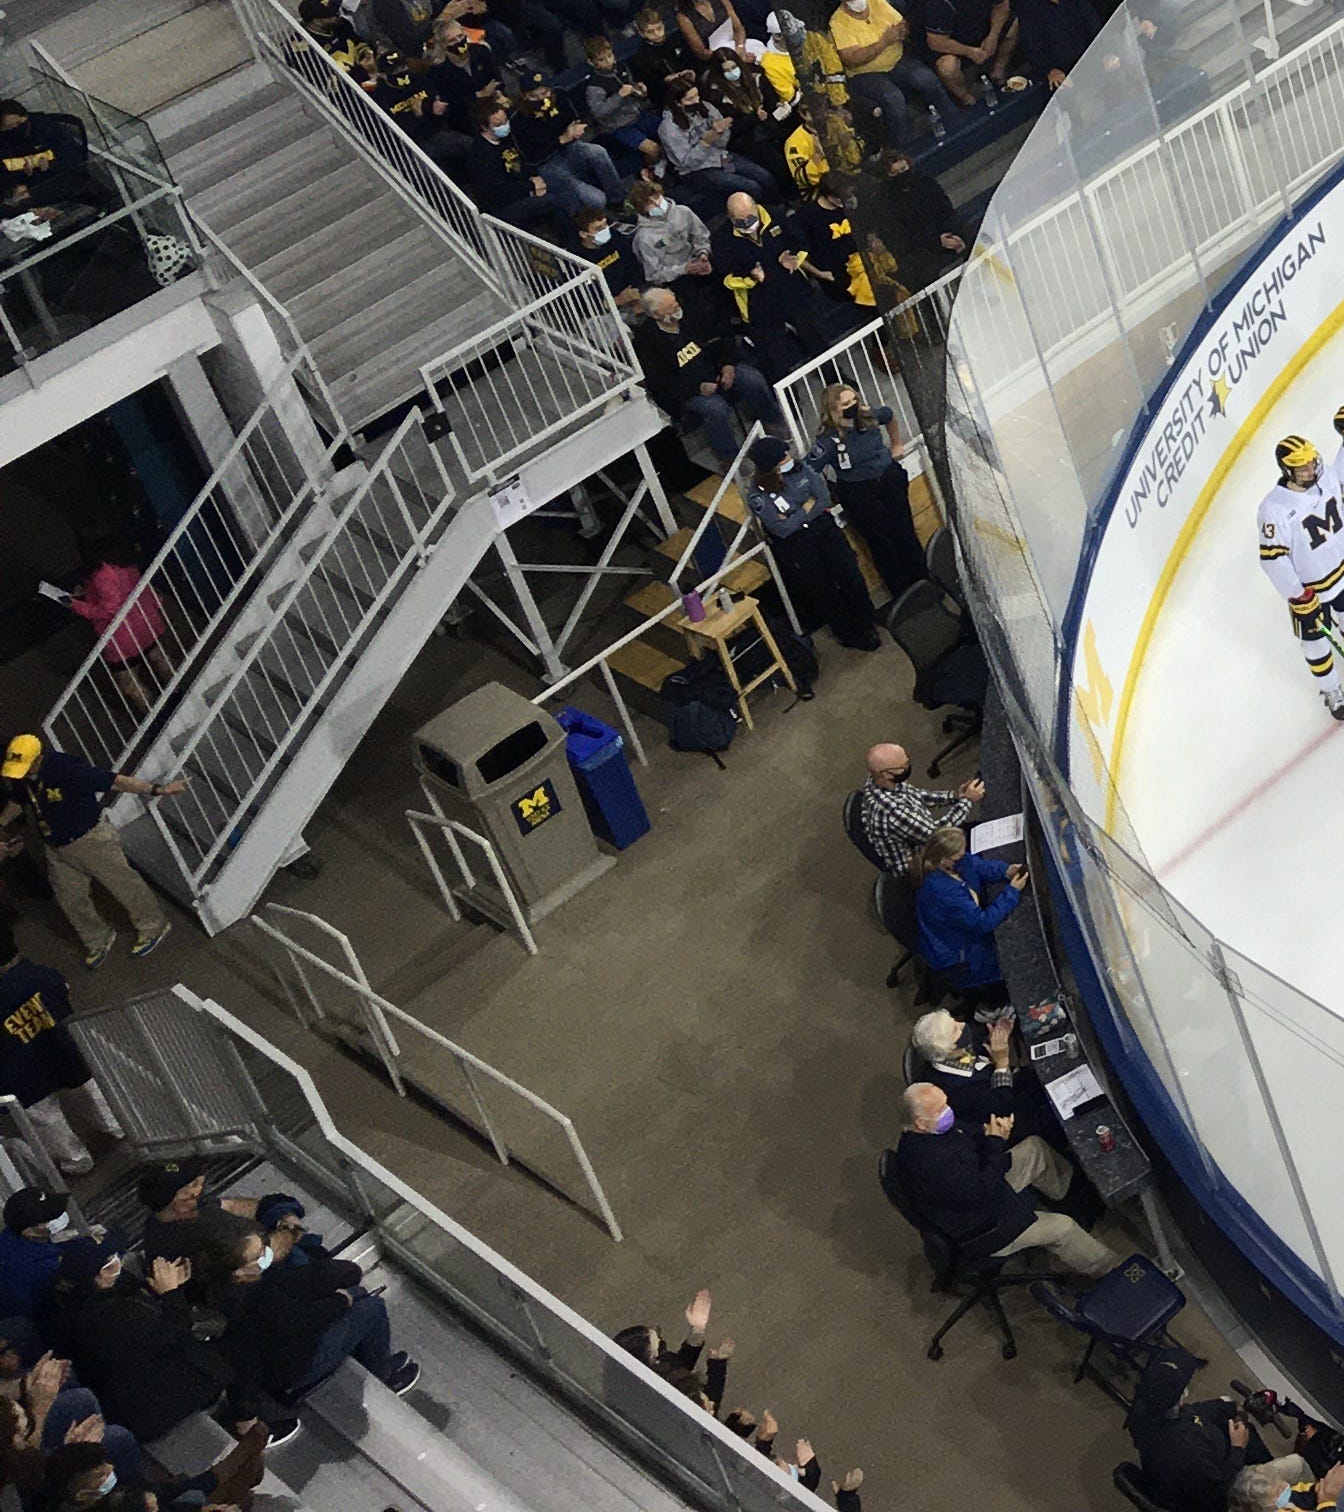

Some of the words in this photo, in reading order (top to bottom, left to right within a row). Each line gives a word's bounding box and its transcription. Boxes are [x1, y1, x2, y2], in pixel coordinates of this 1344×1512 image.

[1125, 368, 1205, 529] UNIVERSITY
[1206, 330, 1231, 376] OF
[1231, 221, 1326, 343] MICHIGAN
[1156, 403, 1208, 508] CREDIT
[1228, 298, 1288, 385] UNION
[1302, 496, 1344, 551] M
[518, 786, 549, 819] M
